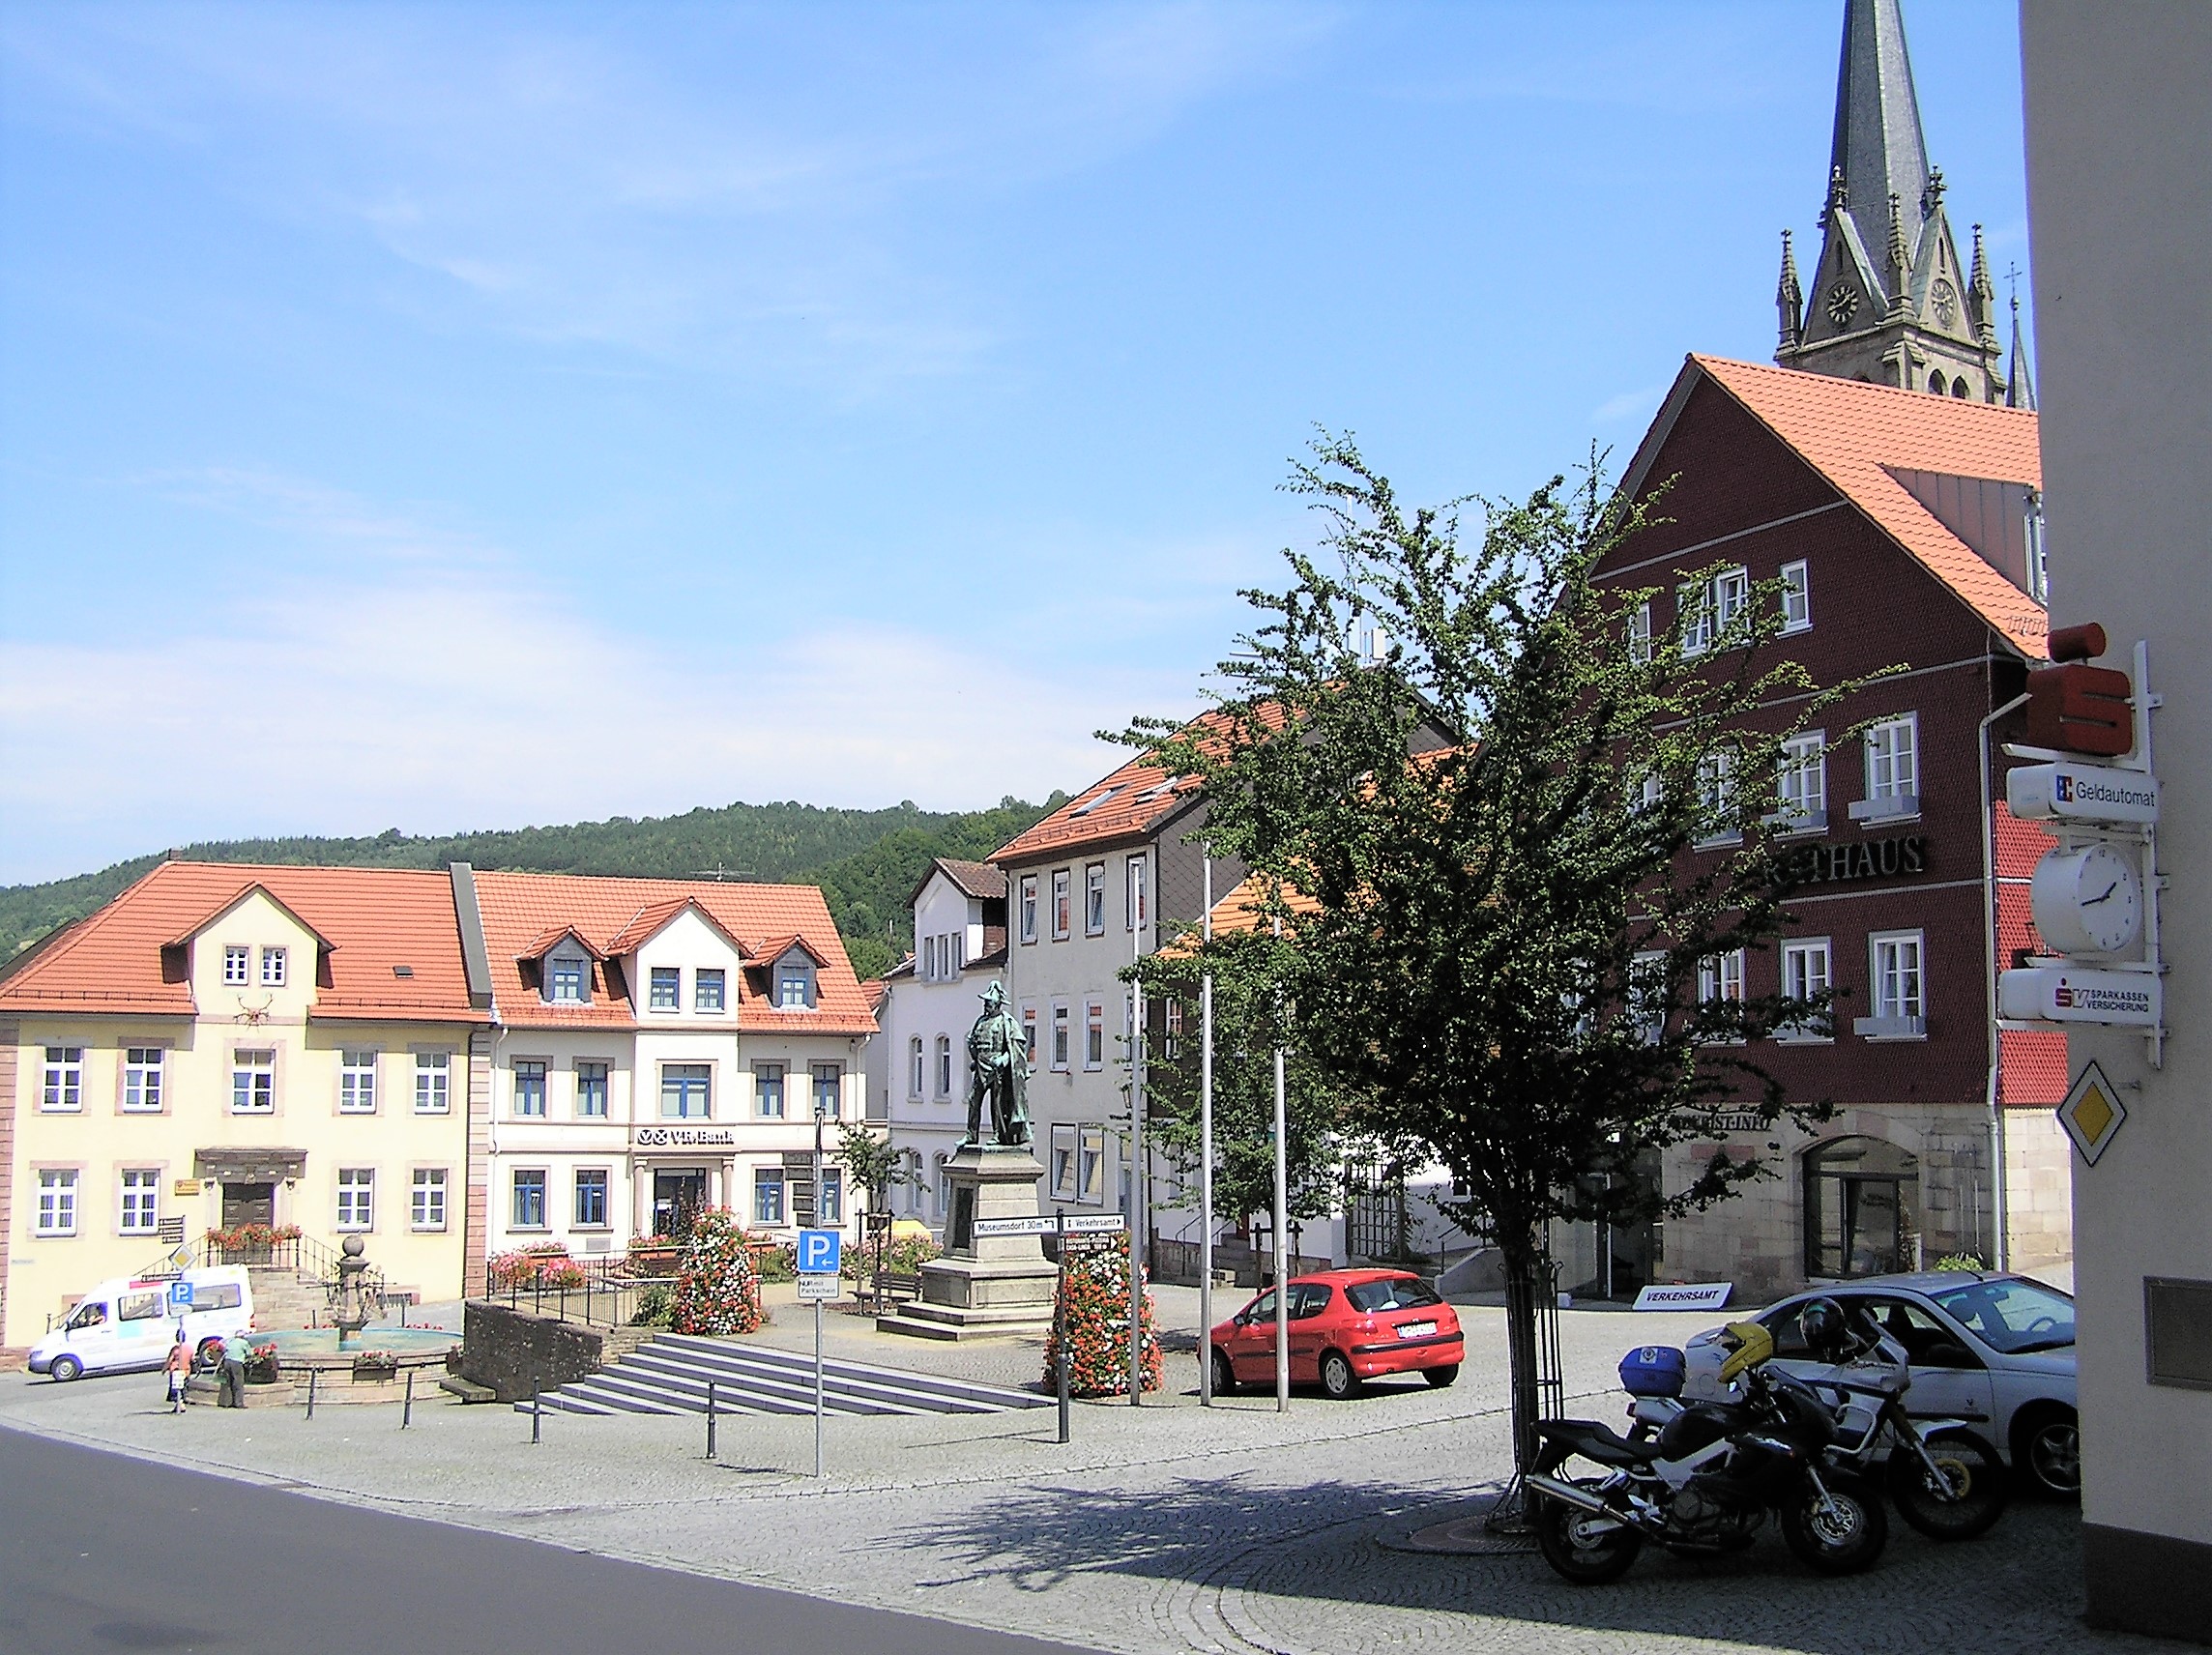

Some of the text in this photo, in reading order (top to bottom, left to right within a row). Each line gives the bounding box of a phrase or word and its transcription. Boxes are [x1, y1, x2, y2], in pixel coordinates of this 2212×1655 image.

[2076, 781, 2155, 807] Geldautomat
[2090, 990, 2149, 1002] SPARKASSEN
[2086, 1002, 2149, 1013] VERSICHERUNG
[977, 1220, 1025, 1233] Museumsdorf
[1075, 1218, 1116, 1228] Verkehrsamt
[807, 1234, 831, 1266] P
[176, 1284, 189, 1301] P
[1645, 1290, 1720, 1302] VERKEHRSAMT
